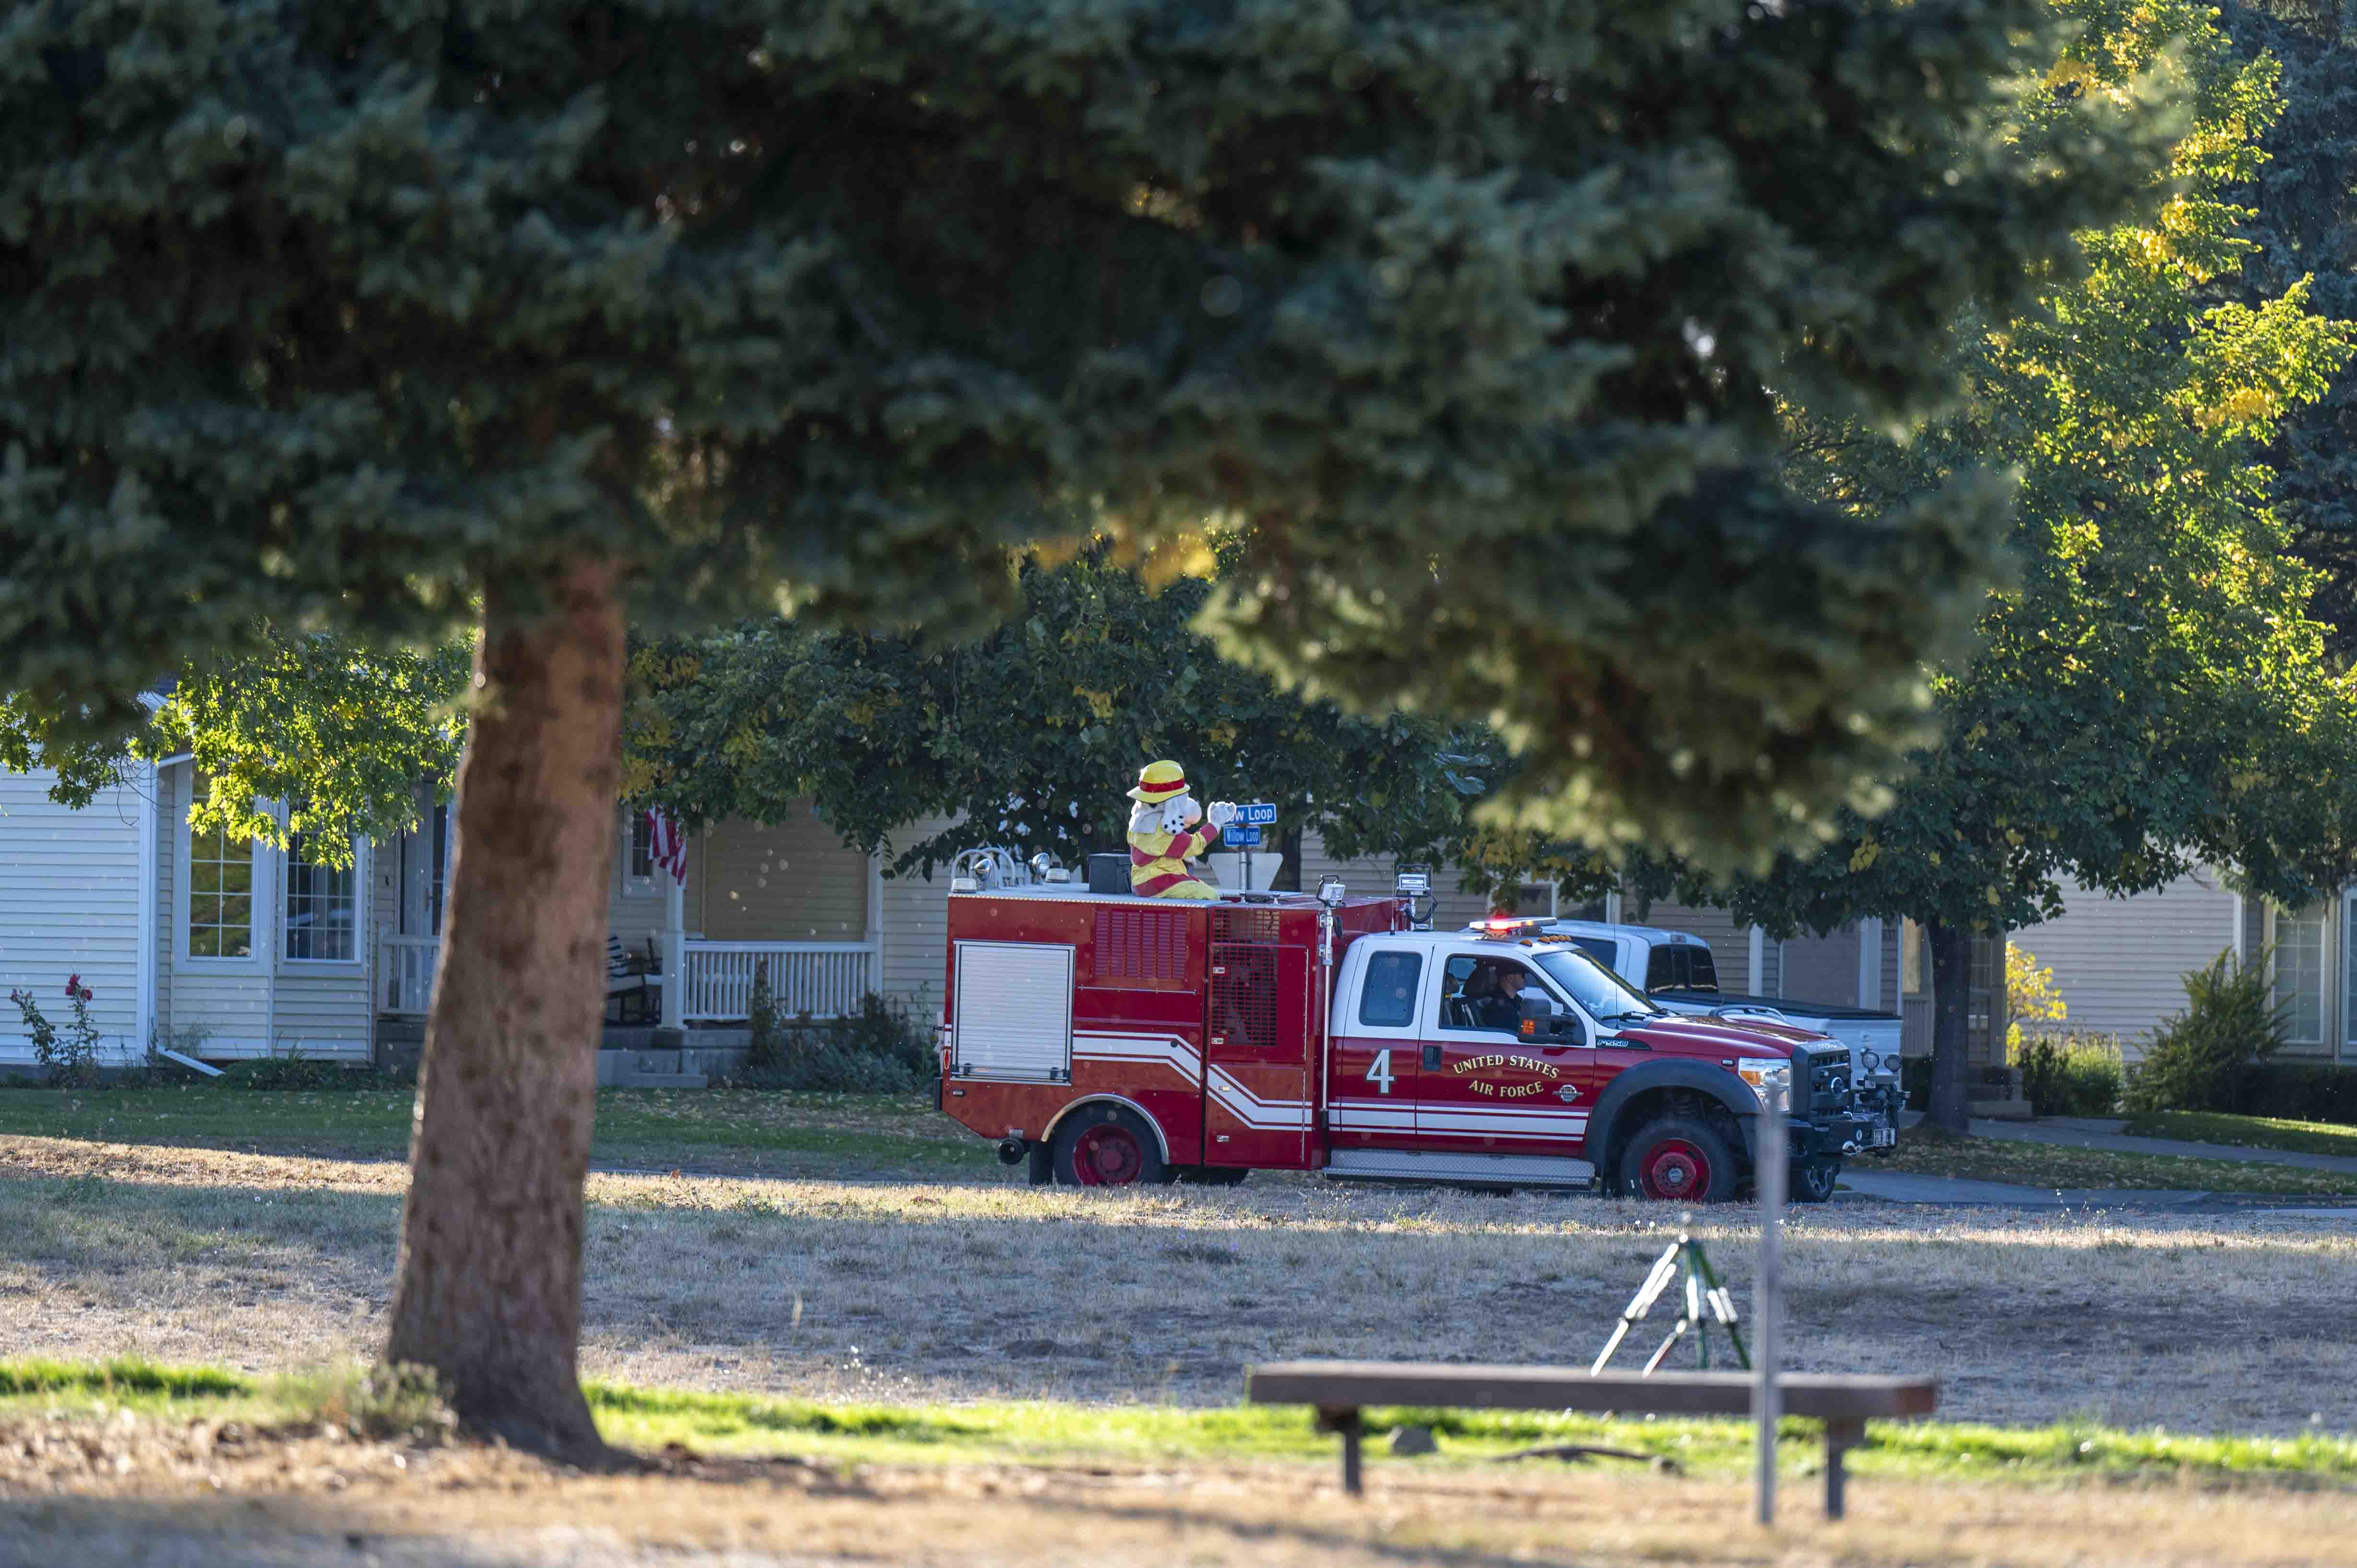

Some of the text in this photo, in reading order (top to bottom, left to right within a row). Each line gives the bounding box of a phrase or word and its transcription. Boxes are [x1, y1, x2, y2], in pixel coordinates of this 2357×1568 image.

[1366, 1049, 1395, 1094] 4
[1453, 1055, 1559, 1078] UNITED STATES
[1469, 1080, 1493, 1096] AIR
[1499, 1081, 1543, 1097] FORCE
